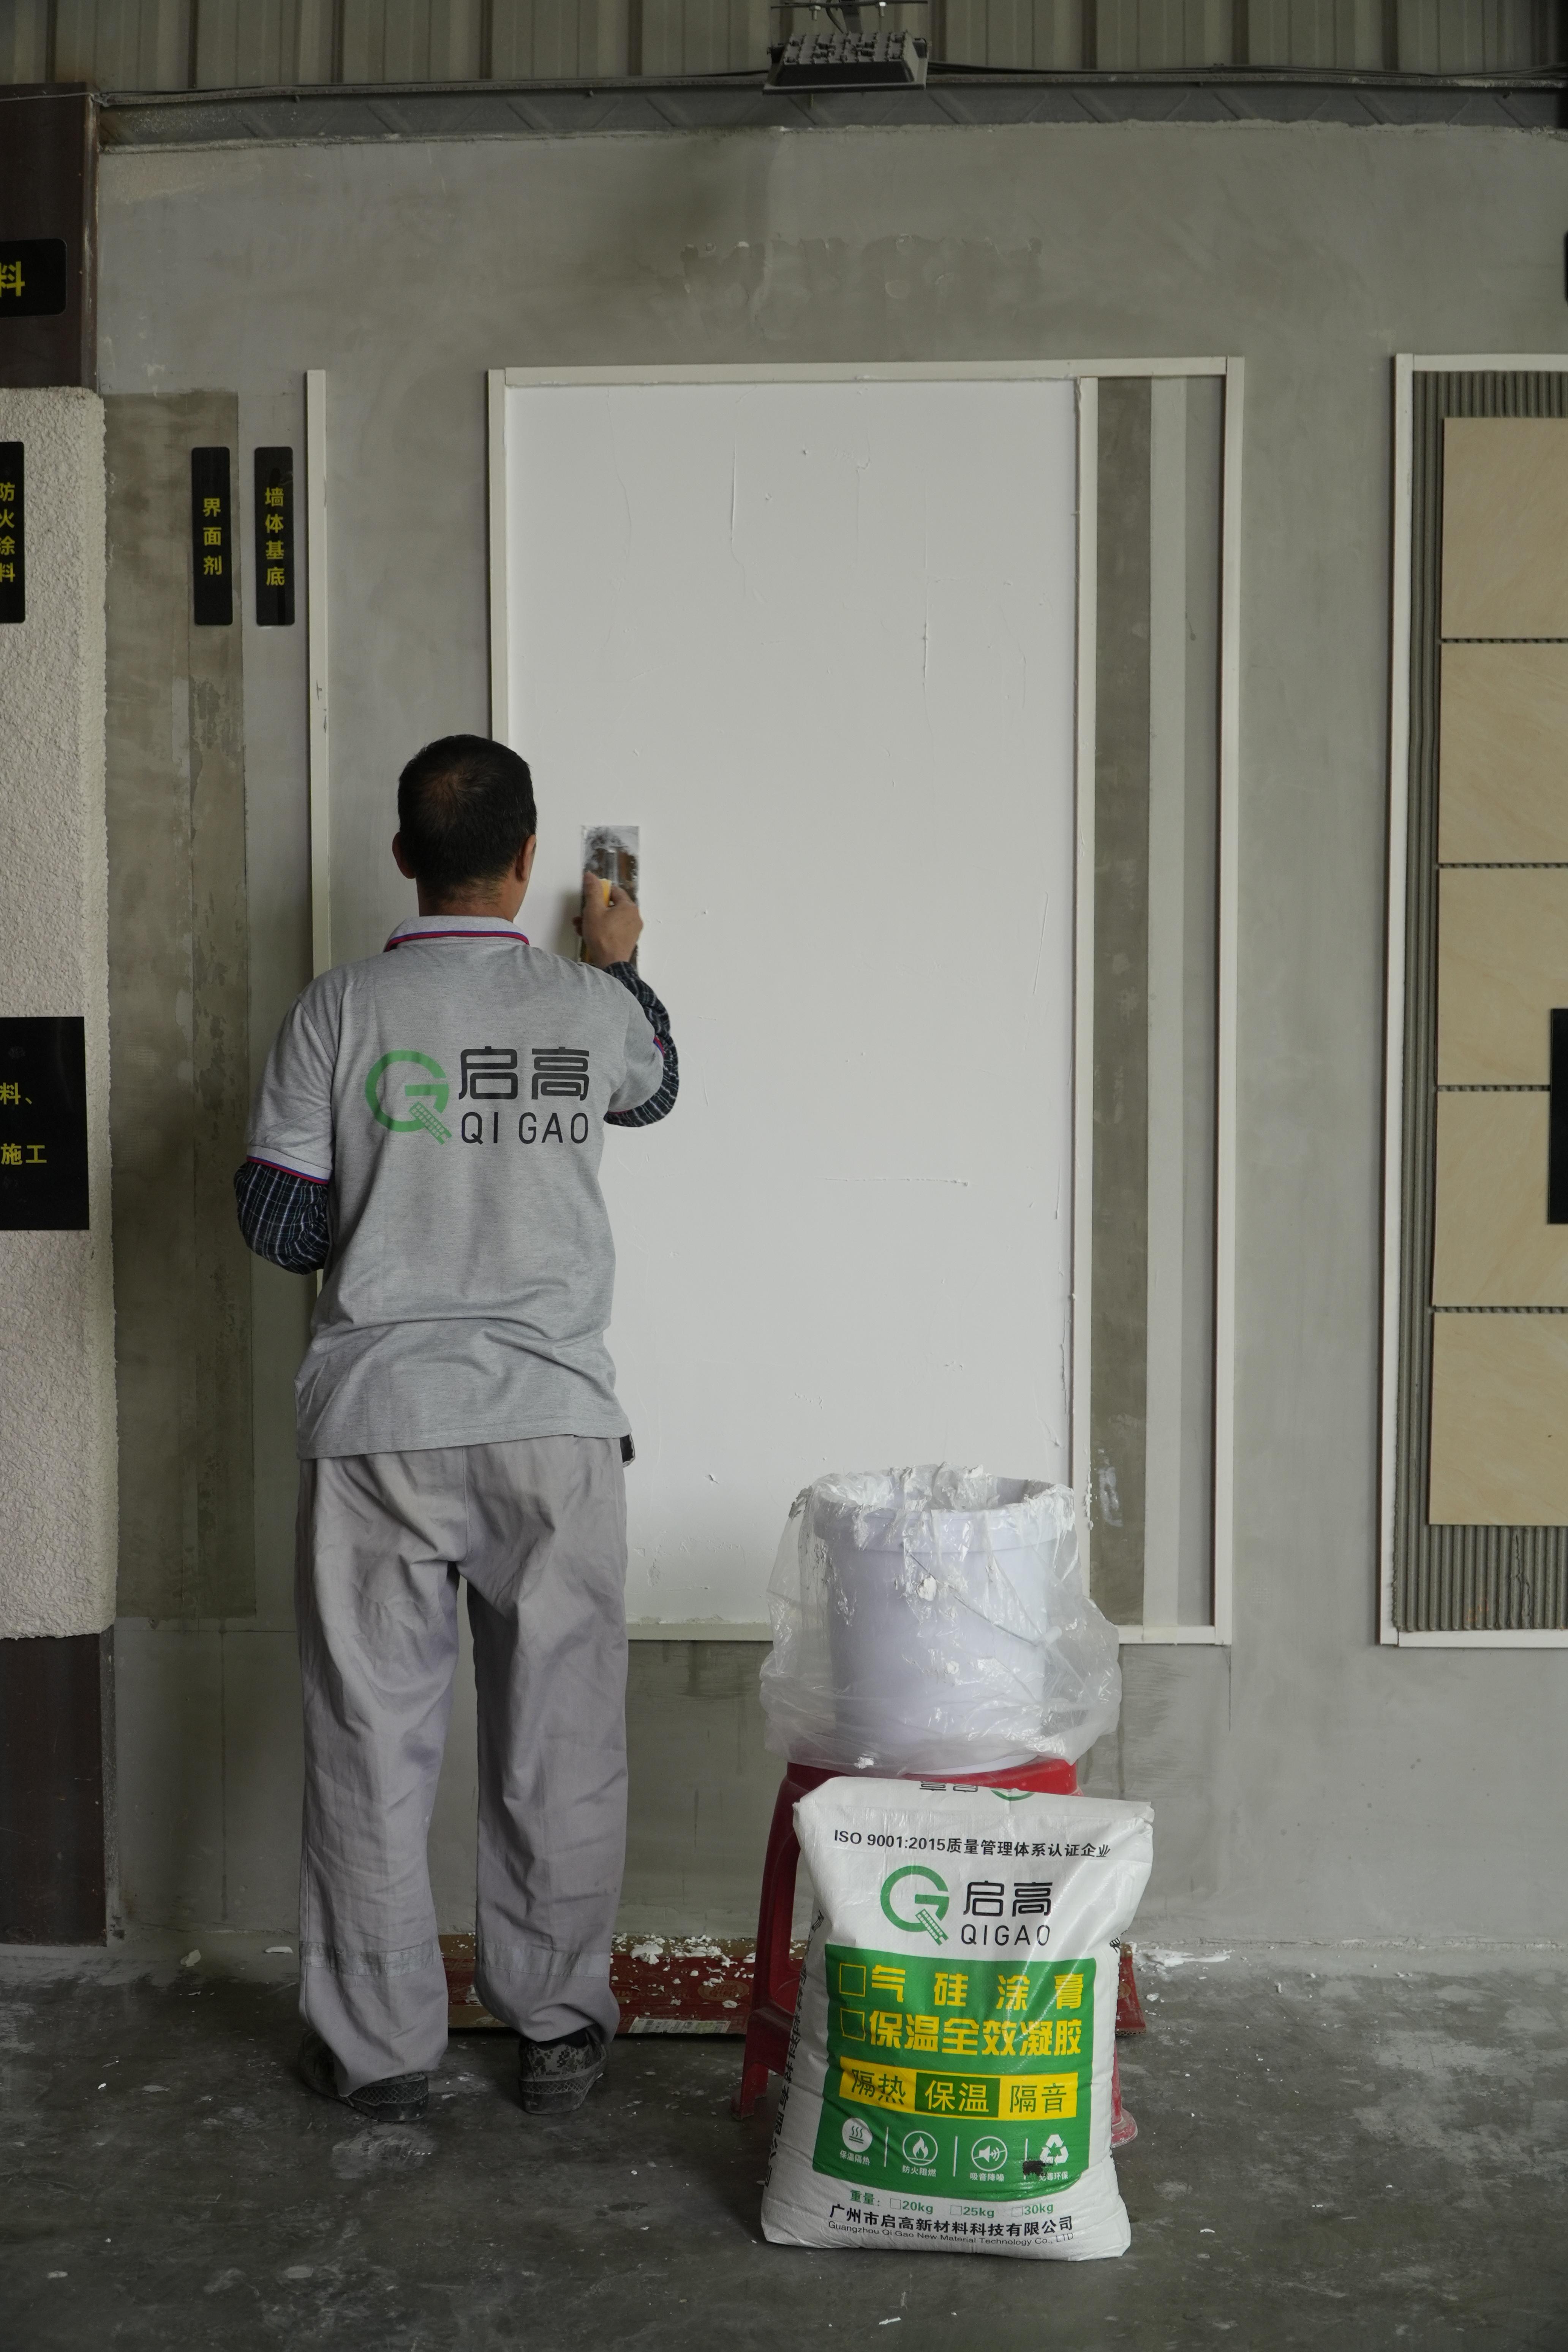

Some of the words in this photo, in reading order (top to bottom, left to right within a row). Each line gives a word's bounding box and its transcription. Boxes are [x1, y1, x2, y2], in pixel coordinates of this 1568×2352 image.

[203, 498, 222, 575] 界面剂
[265, 487, 285, 586] 墙体基底
[458, 1046, 590, 1101] 启高
[0, 1143, 47, 1165] 施工
[834, 1830, 862, 1845] ISO
[963, 1881, 1053, 1917] 启高
[961, 1924, 1051, 1946] QIGAO
[869, 2010, 1082, 2056] 保温全效凝胶
[851, 2069, 906, 2105] 隔热
[925, 2080, 989, 2112] 保温
[1009, 2083, 1067, 2113] 隔音
[839, 2149, 871, 2166] 保温隔热
[902, 2165, 937, 2177] 防火阻燃
[970, 2172, 1004, 2182] 吸音降噪
[829, 2204, 1073, 2237] 广州市启高新材料科技有限公司
[902, 2200, 934, 2214] 20kg
[963, 2207, 995, 2218] 25kg
[1024, 2203, 1054, 2216] 30kg
[828, 2221, 879, 2234] Guangzhou
[940, 2234, 976, 2243] Material
[979, 2238, 1032, 2246] Technology
[1056, 2232, 1074, 2243] LTD
